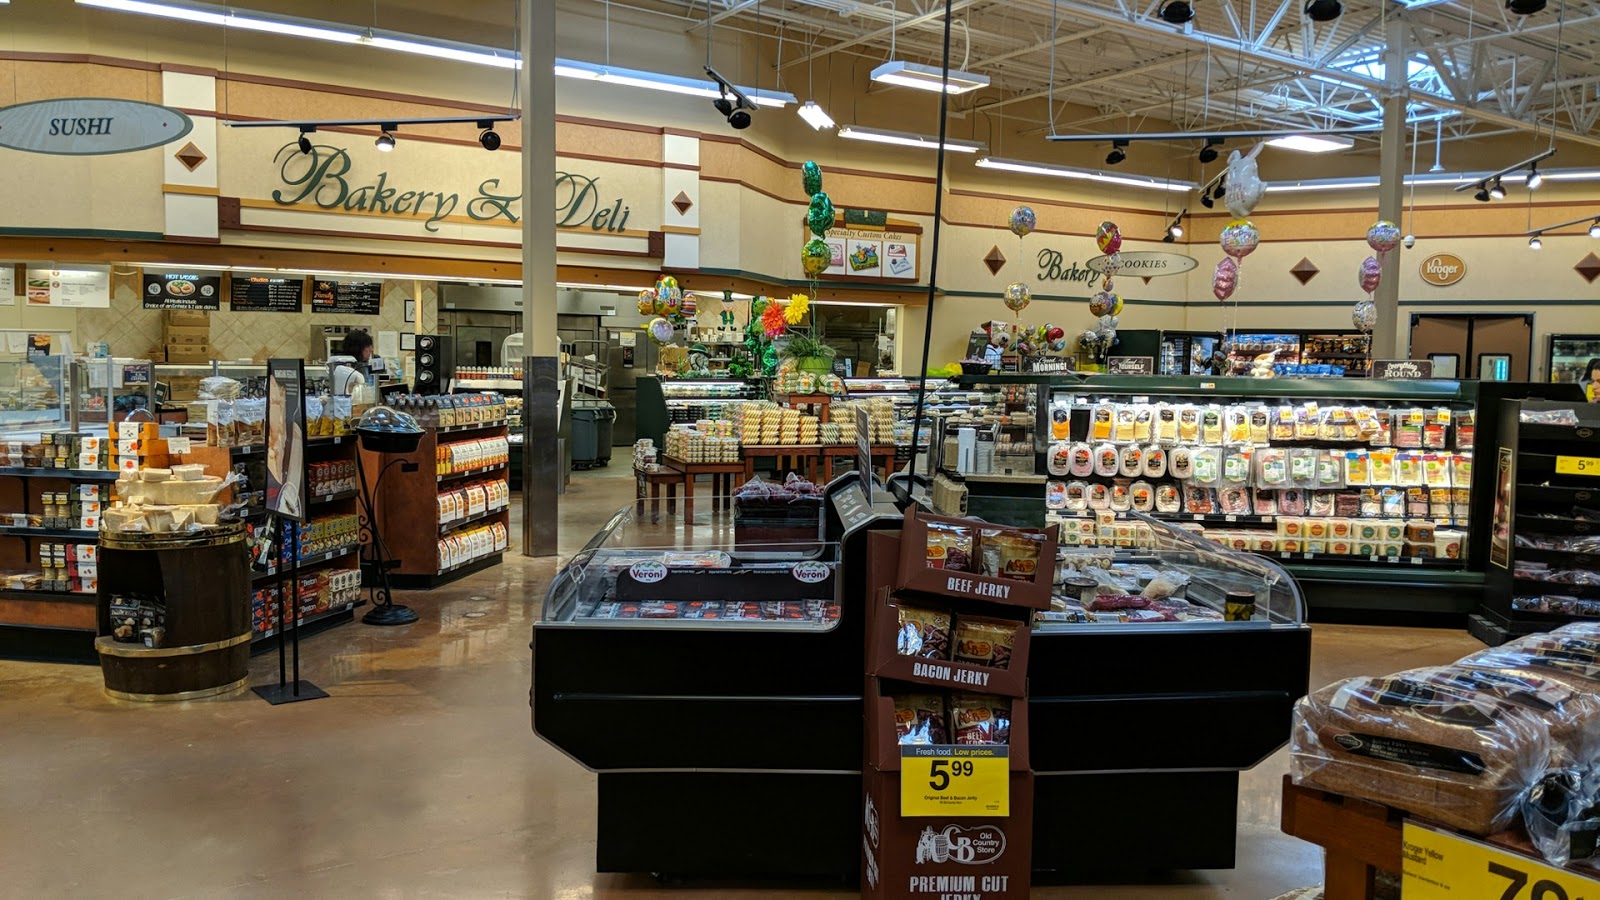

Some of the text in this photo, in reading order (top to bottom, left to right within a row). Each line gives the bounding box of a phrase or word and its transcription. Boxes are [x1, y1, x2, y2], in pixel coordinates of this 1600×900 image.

[48, 117, 114, 137] SUSHI
[272, 141, 630, 233] Bakery & Deli
[826, 229, 902, 240] Specialty Custom Cakes
[1037, 248, 1100, 287] Bakery
[1120, 259, 1168, 269] COOKIES
[1427, 257, 1459, 280] Kroger
[1384, 369, 1422, 378] ROUND
[632, 569, 663, 579] Veroni
[800, 569, 826, 579] Veroni
[947, 576, 1011, 600] BEEF JERKY
[913, 662, 990, 687] BACON JERKY
[916, 748, 994, 757] Fresh food. Low prices.
[979, 832, 992, 840] Old
[972, 839, 1000, 848] Country
[976, 846, 996, 854] Store
[909, 876, 1009, 893] PREMIUM CUT
